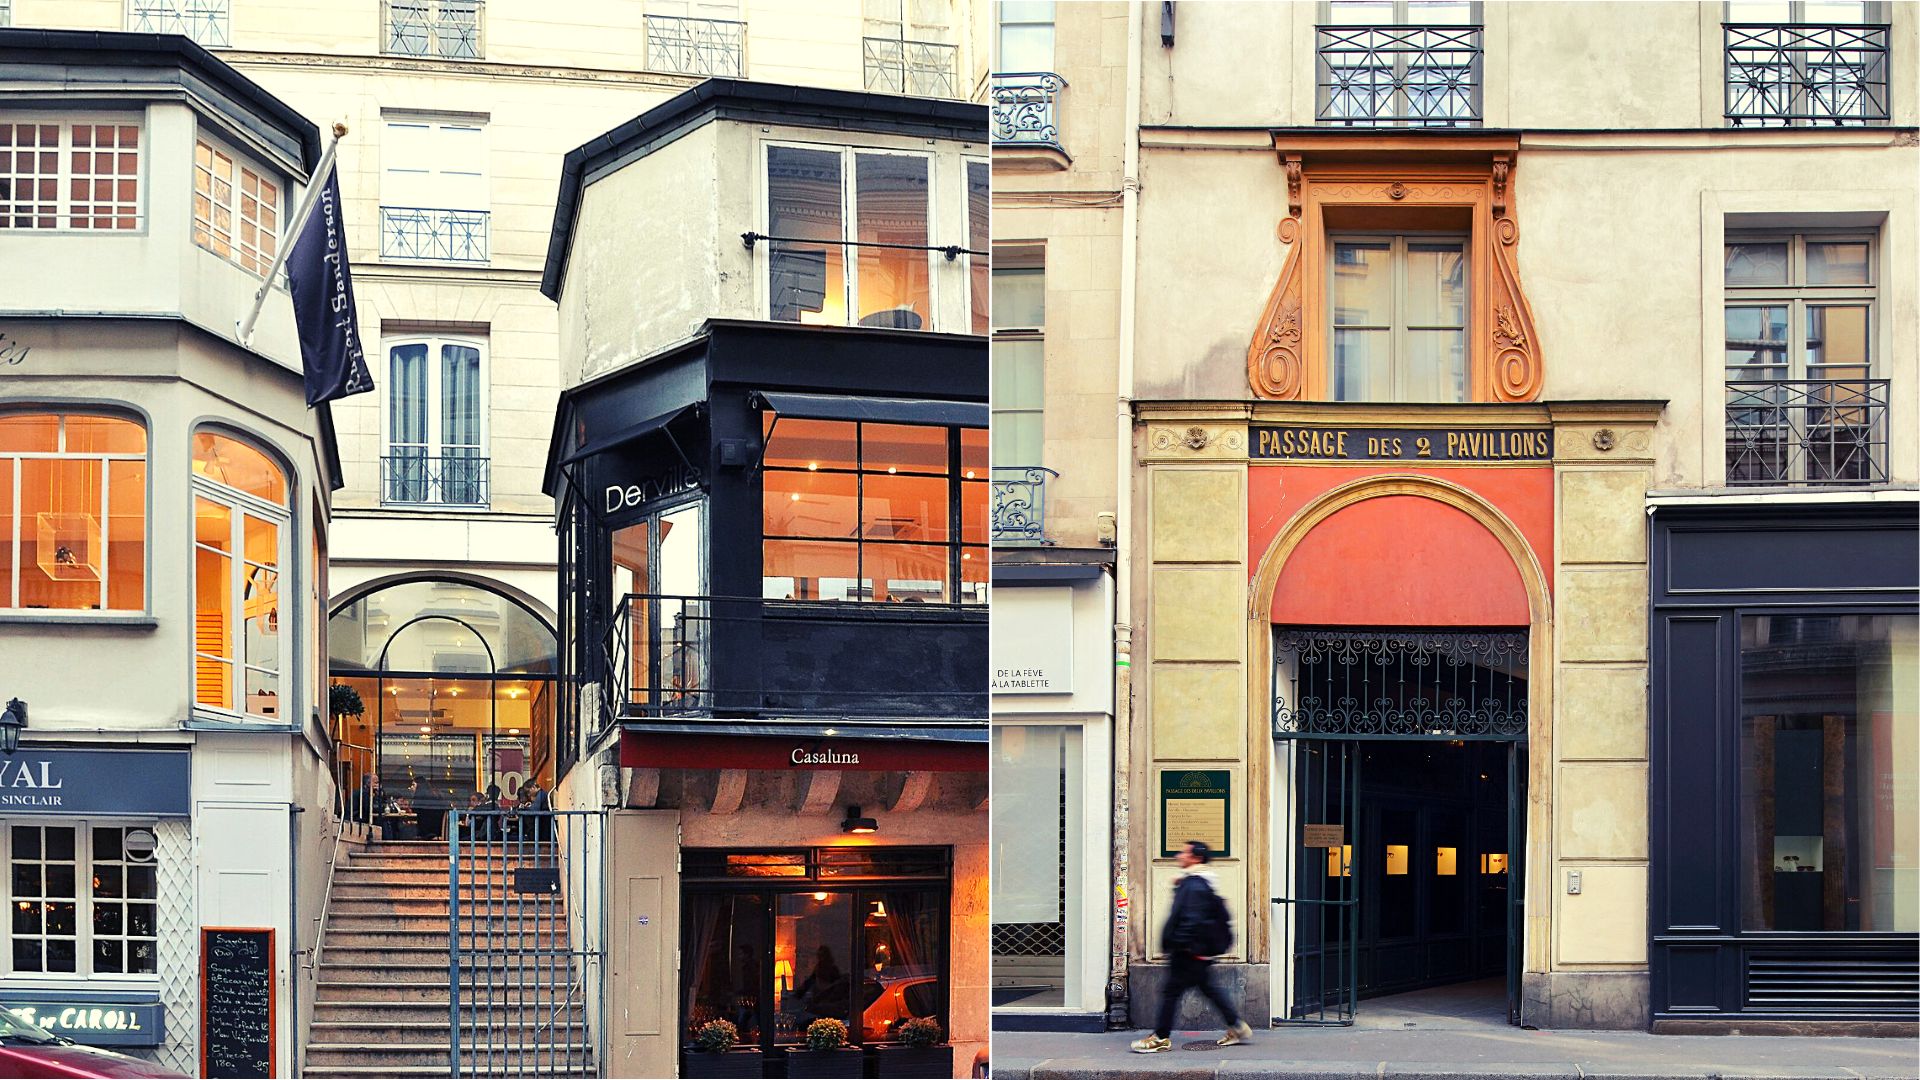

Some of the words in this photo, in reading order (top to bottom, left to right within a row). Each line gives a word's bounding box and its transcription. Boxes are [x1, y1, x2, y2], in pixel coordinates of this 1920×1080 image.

[321, 188, 347, 313] Sanderson
[336, 316, 364, 395] Rupert
[1259, 430, 1348, 457] PASSAGE
[1368, 437, 1403, 456] DES
[1416, 437, 1431, 457] 2
[1447, 431, 1549, 458] PAVILLONS
[606, 467, 701, 514] Derville
[997, 669, 1009, 678] DE
[1011, 669, 1022, 678] LA
[1000, 680, 1010, 688] LA
[1011, 680, 1050, 688] TABLETTE
[791, 748, 860, 764] Casaluna
[2, 795, 63, 806] SINCLAIR
[60, 1008, 141, 1031] CAROLL
